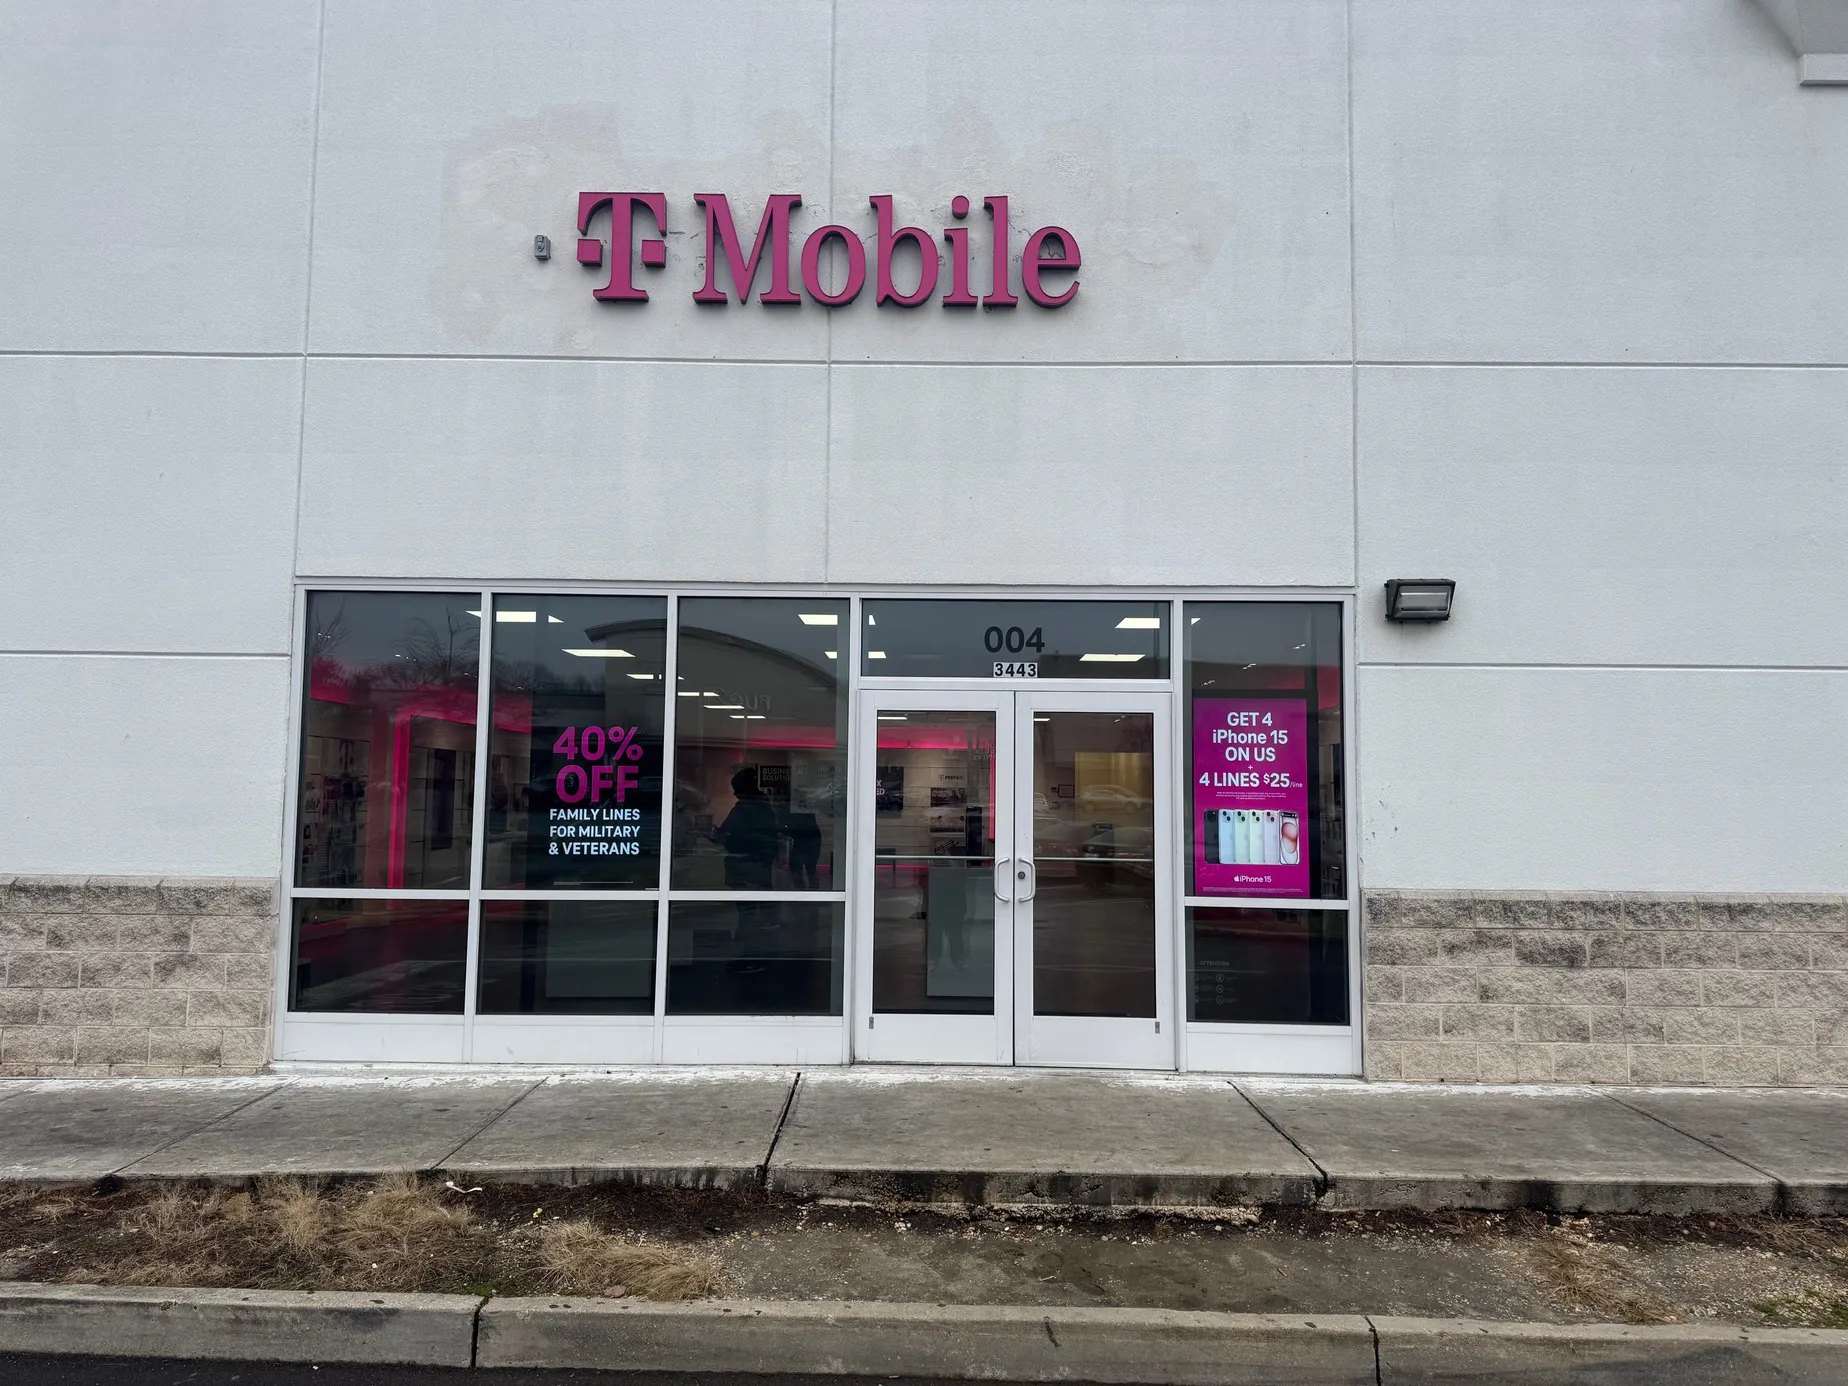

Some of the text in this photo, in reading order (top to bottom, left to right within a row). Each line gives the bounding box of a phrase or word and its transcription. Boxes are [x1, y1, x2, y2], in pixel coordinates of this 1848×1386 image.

[692, 193, 1082, 309] Mobile
[984, 626, 1046, 653] 004
[994, 662, 1037, 677] 3443
[1227, 712, 1273, 727] GET 4
[553, 725, 644, 761] 40%
[1212, 729, 1288, 745] iPhone 15
[1225, 747, 1276, 762] ON US
[556, 764, 639, 803] OFF
[1199, 772, 1210, 787] 4
[1213, 772, 1260, 788] LINES
[549, 809, 640, 821] FAMILY LINES
[549, 826, 641, 838] FOR MILITARY
[548, 842, 640, 855] & VETERANS
[1240, 875, 1272, 883] iPhone 15
